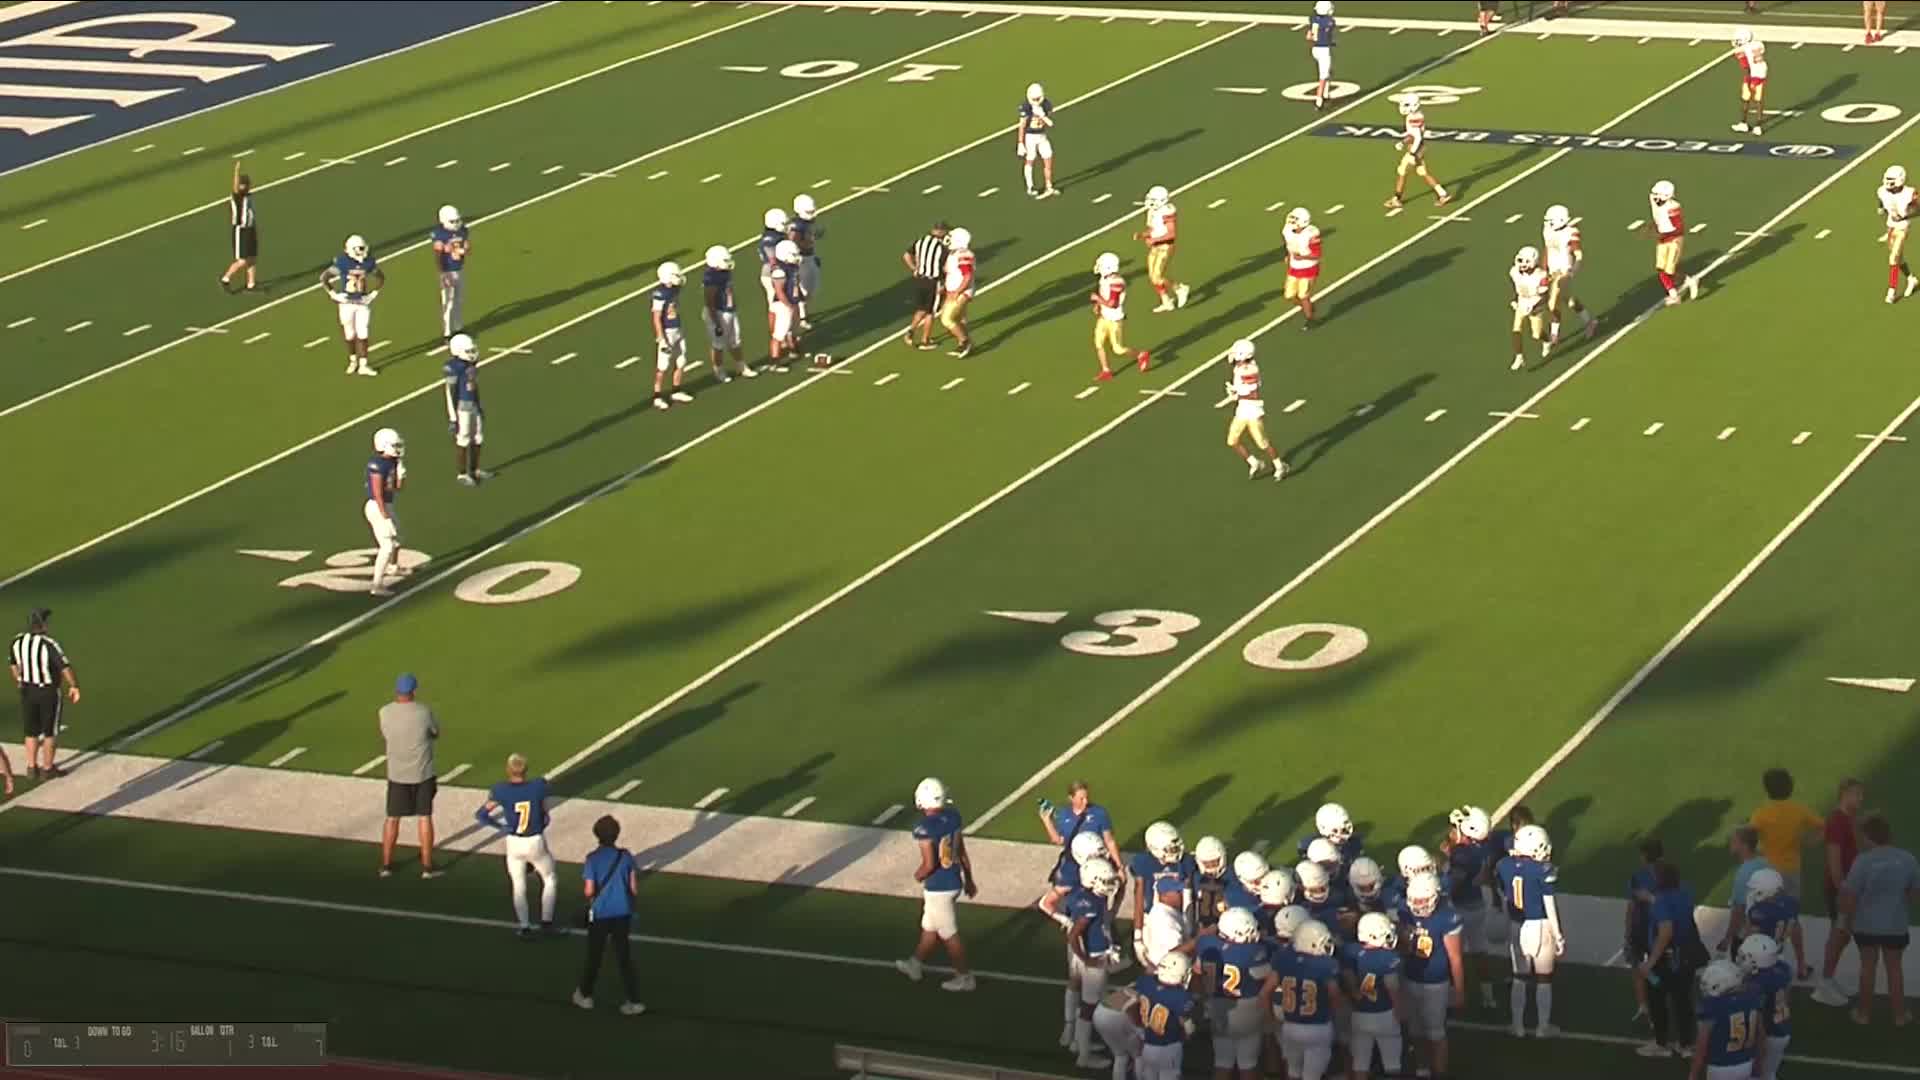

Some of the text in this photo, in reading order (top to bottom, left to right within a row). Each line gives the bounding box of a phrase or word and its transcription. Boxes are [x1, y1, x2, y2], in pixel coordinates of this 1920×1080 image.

[1508, 132, 1745, 153] PEOPLES
[1060, 608, 1369, 670] 30
[514, 800, 531, 834] 7
